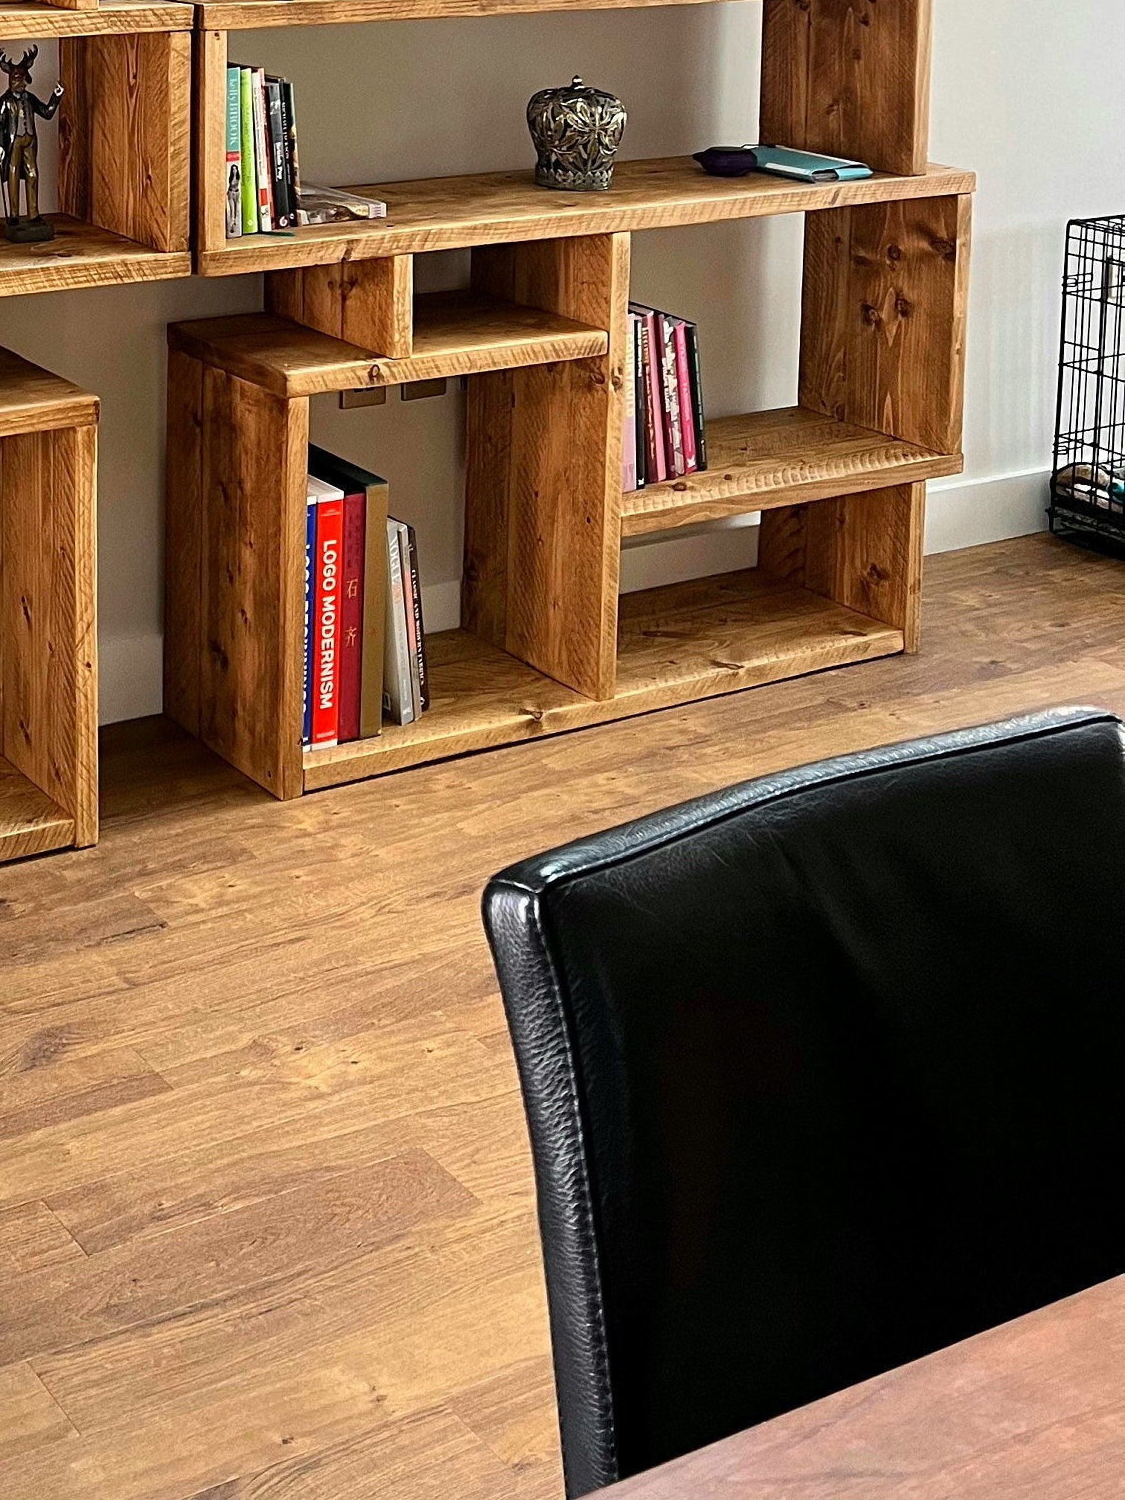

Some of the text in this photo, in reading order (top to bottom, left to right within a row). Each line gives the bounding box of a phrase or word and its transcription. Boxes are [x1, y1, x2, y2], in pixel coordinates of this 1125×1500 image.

[389, 536, 402, 584] VOGUE
[319, 539, 337, 710] LOGO MODERNISM
